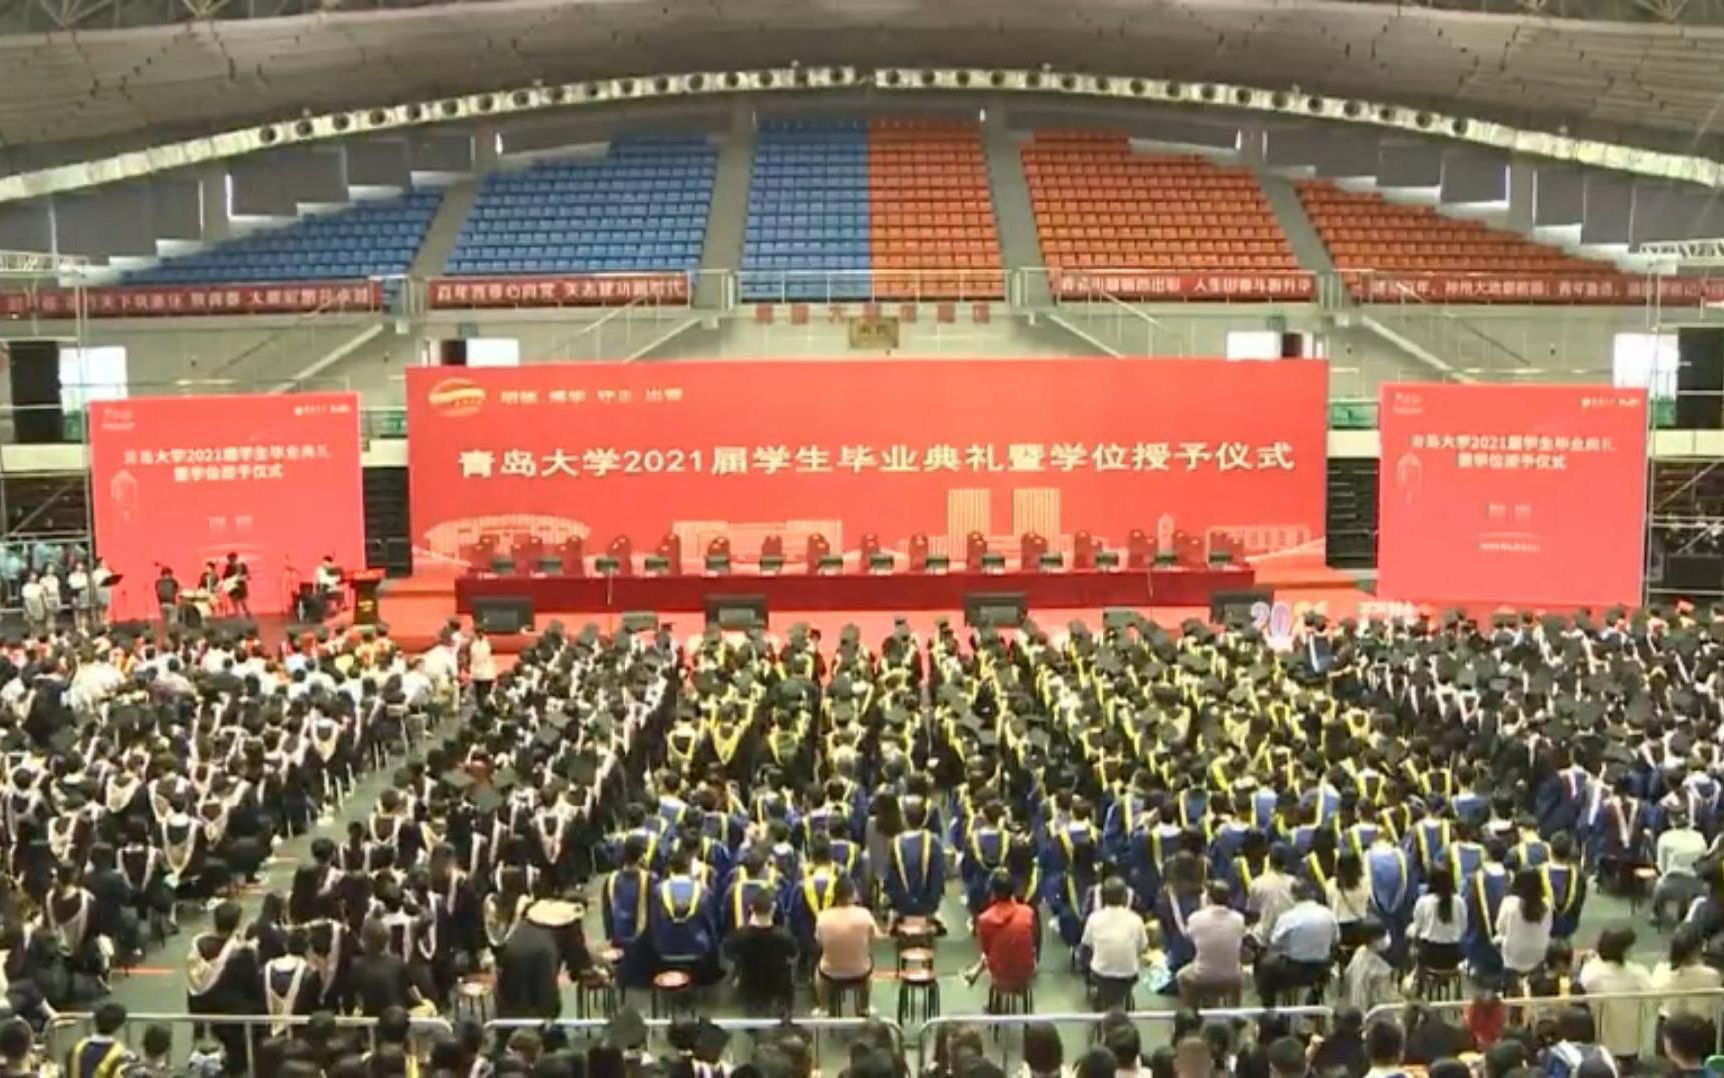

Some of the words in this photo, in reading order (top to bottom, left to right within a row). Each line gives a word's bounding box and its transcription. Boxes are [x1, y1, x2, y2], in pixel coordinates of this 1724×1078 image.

[458, 442, 1295, 478] 青岛大学2021届学生毕业典礼暨学位授予仪式
